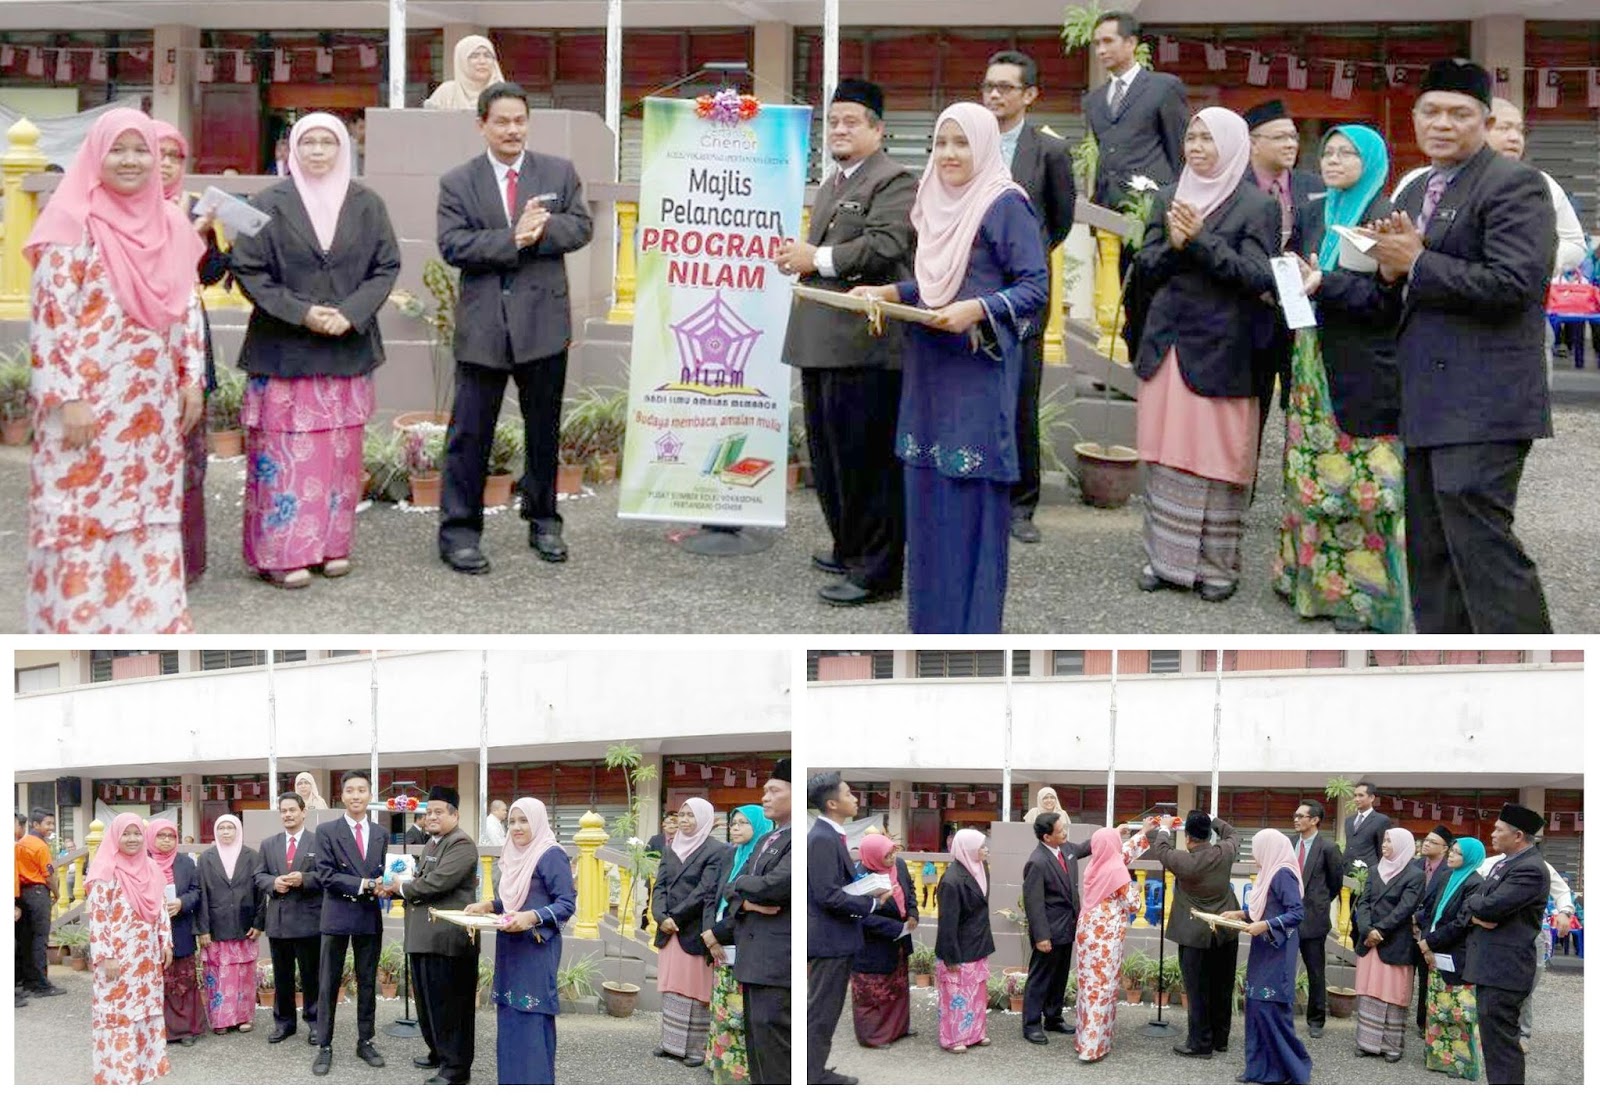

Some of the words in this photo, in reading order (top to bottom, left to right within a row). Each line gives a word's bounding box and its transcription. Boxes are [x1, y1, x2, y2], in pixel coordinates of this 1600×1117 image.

[689, 168, 752, 201] Majlis
[661, 198, 782, 230] Pelancaran
[667, 260, 766, 290] NILAM
[680, 366, 744, 388] NILAM
[635, 410, 670, 431] Budaya
[720, 413, 755, 427] amalan
